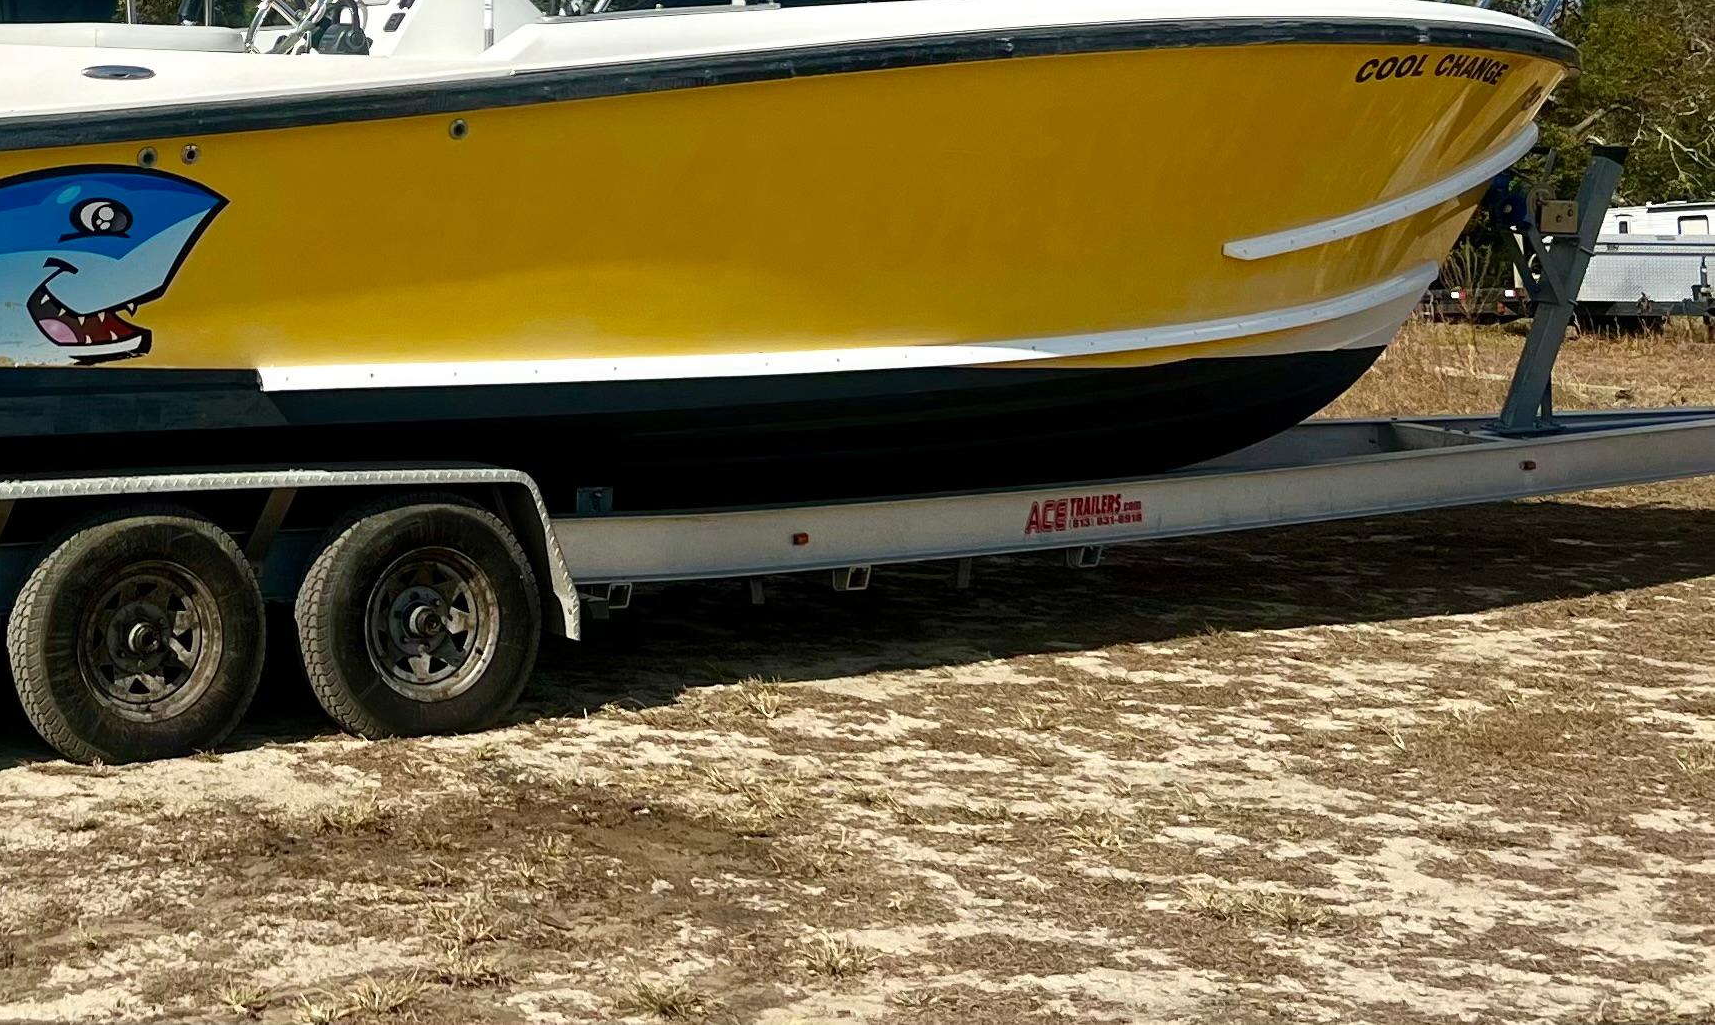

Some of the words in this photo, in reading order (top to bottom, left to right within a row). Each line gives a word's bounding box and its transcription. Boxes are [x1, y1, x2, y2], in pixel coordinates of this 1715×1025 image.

[1355, 54, 1429, 83] COOL
[1435, 54, 1509, 86] CHANGE
[1025, 499, 1068, 534] ACE
